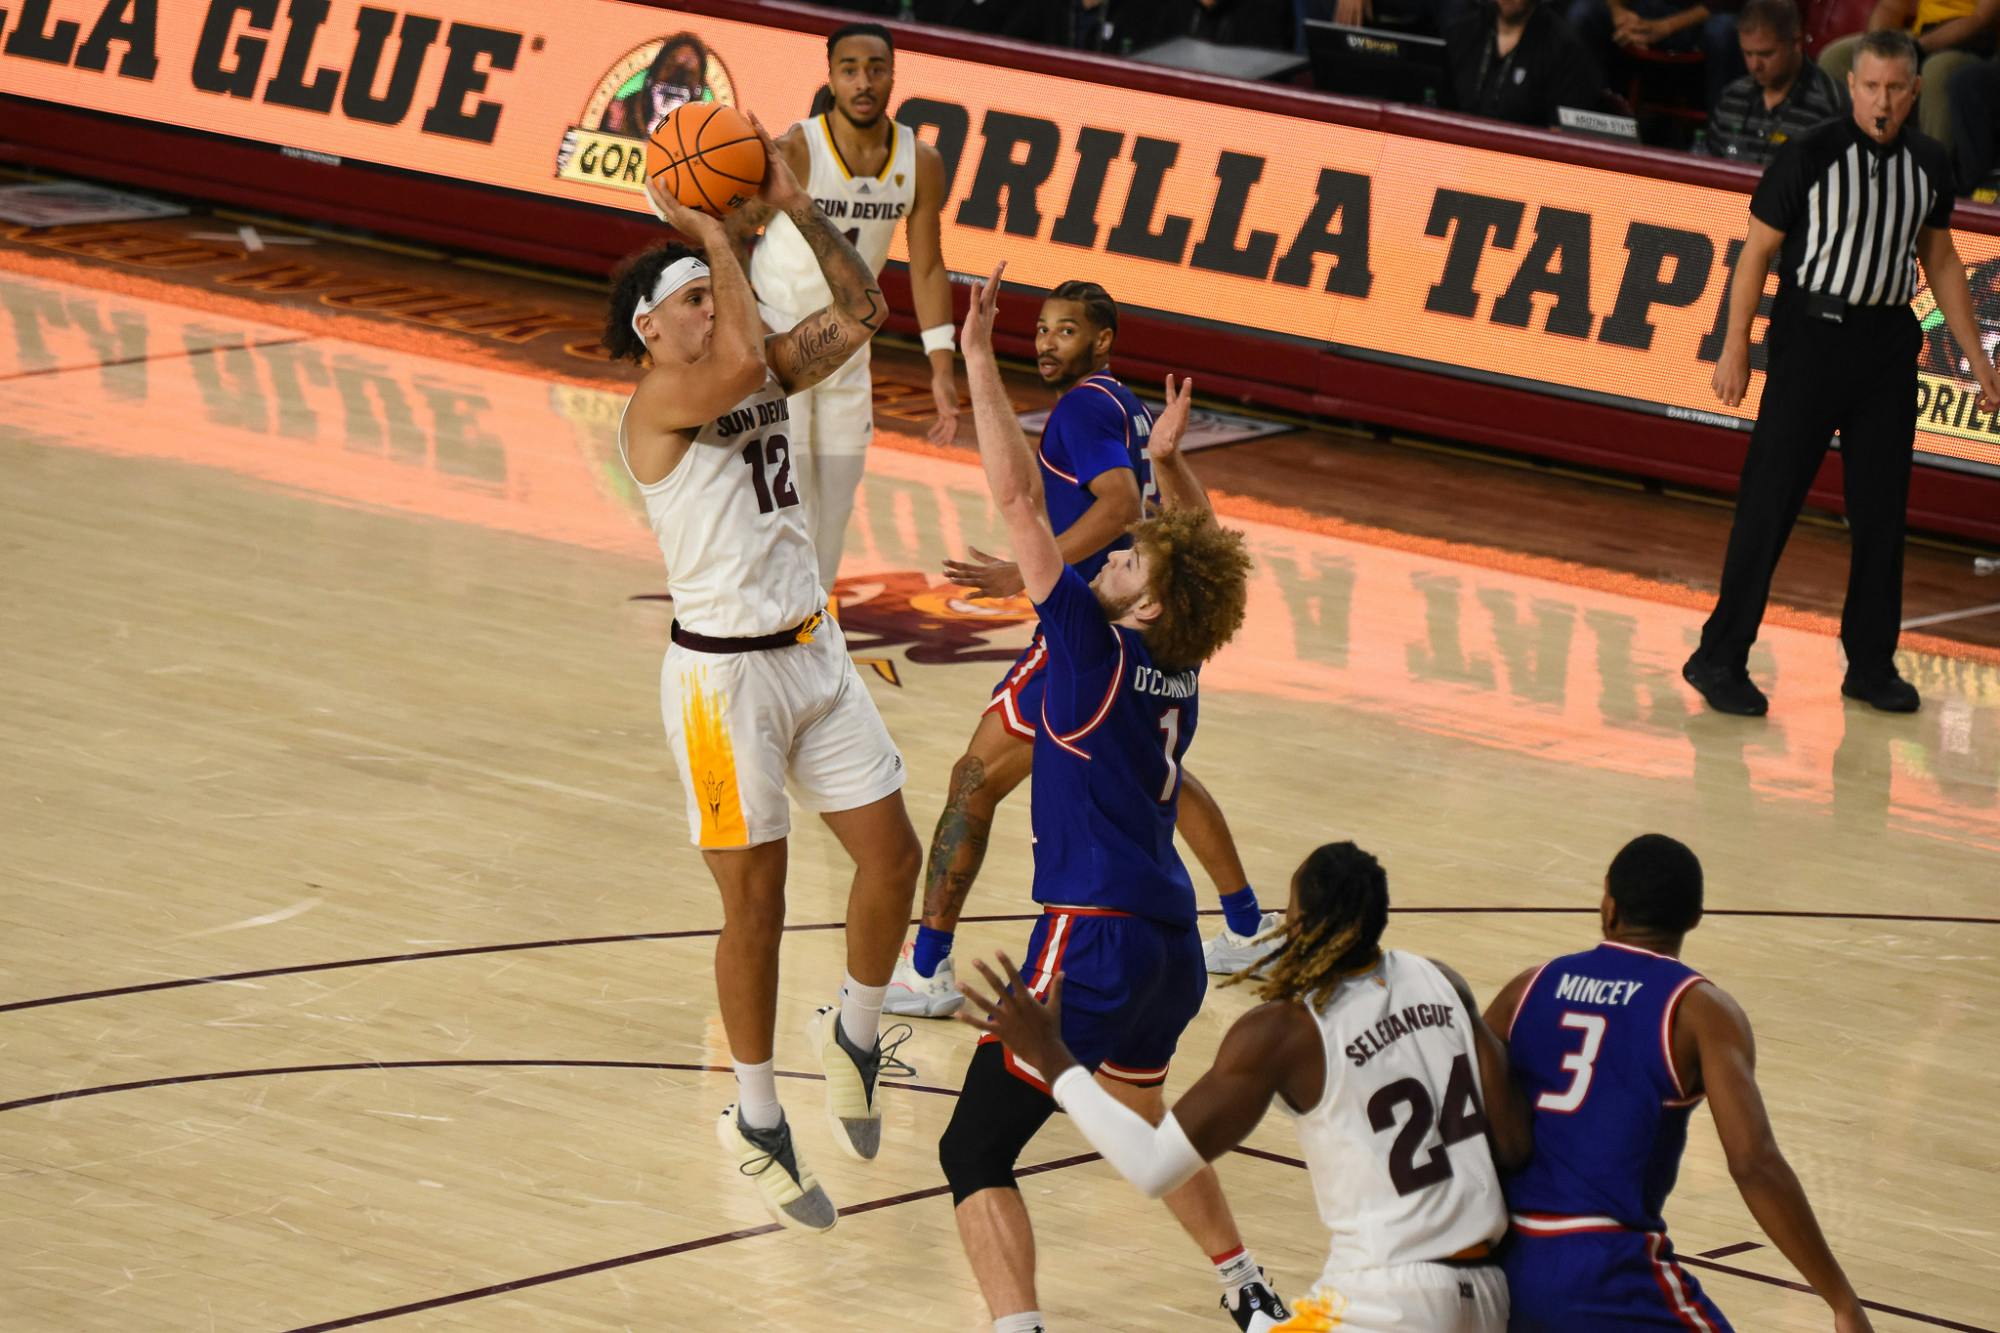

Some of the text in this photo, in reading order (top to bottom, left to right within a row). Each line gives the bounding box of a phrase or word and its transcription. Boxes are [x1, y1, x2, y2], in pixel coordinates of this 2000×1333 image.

[191, 0, 524, 144] GLUE
[808, 85, 1372, 298] ORILLA
[852, 202, 906, 220] DEVILS
[717, 407, 756, 438] SUN
[741, 433, 800, 515] 12
[1159, 707, 1181, 802] 1
[1555, 973, 1644, 1006] MINCEY
[1536, 1011, 1608, 1114] 3
[1366, 1052, 1487, 1198] 24
